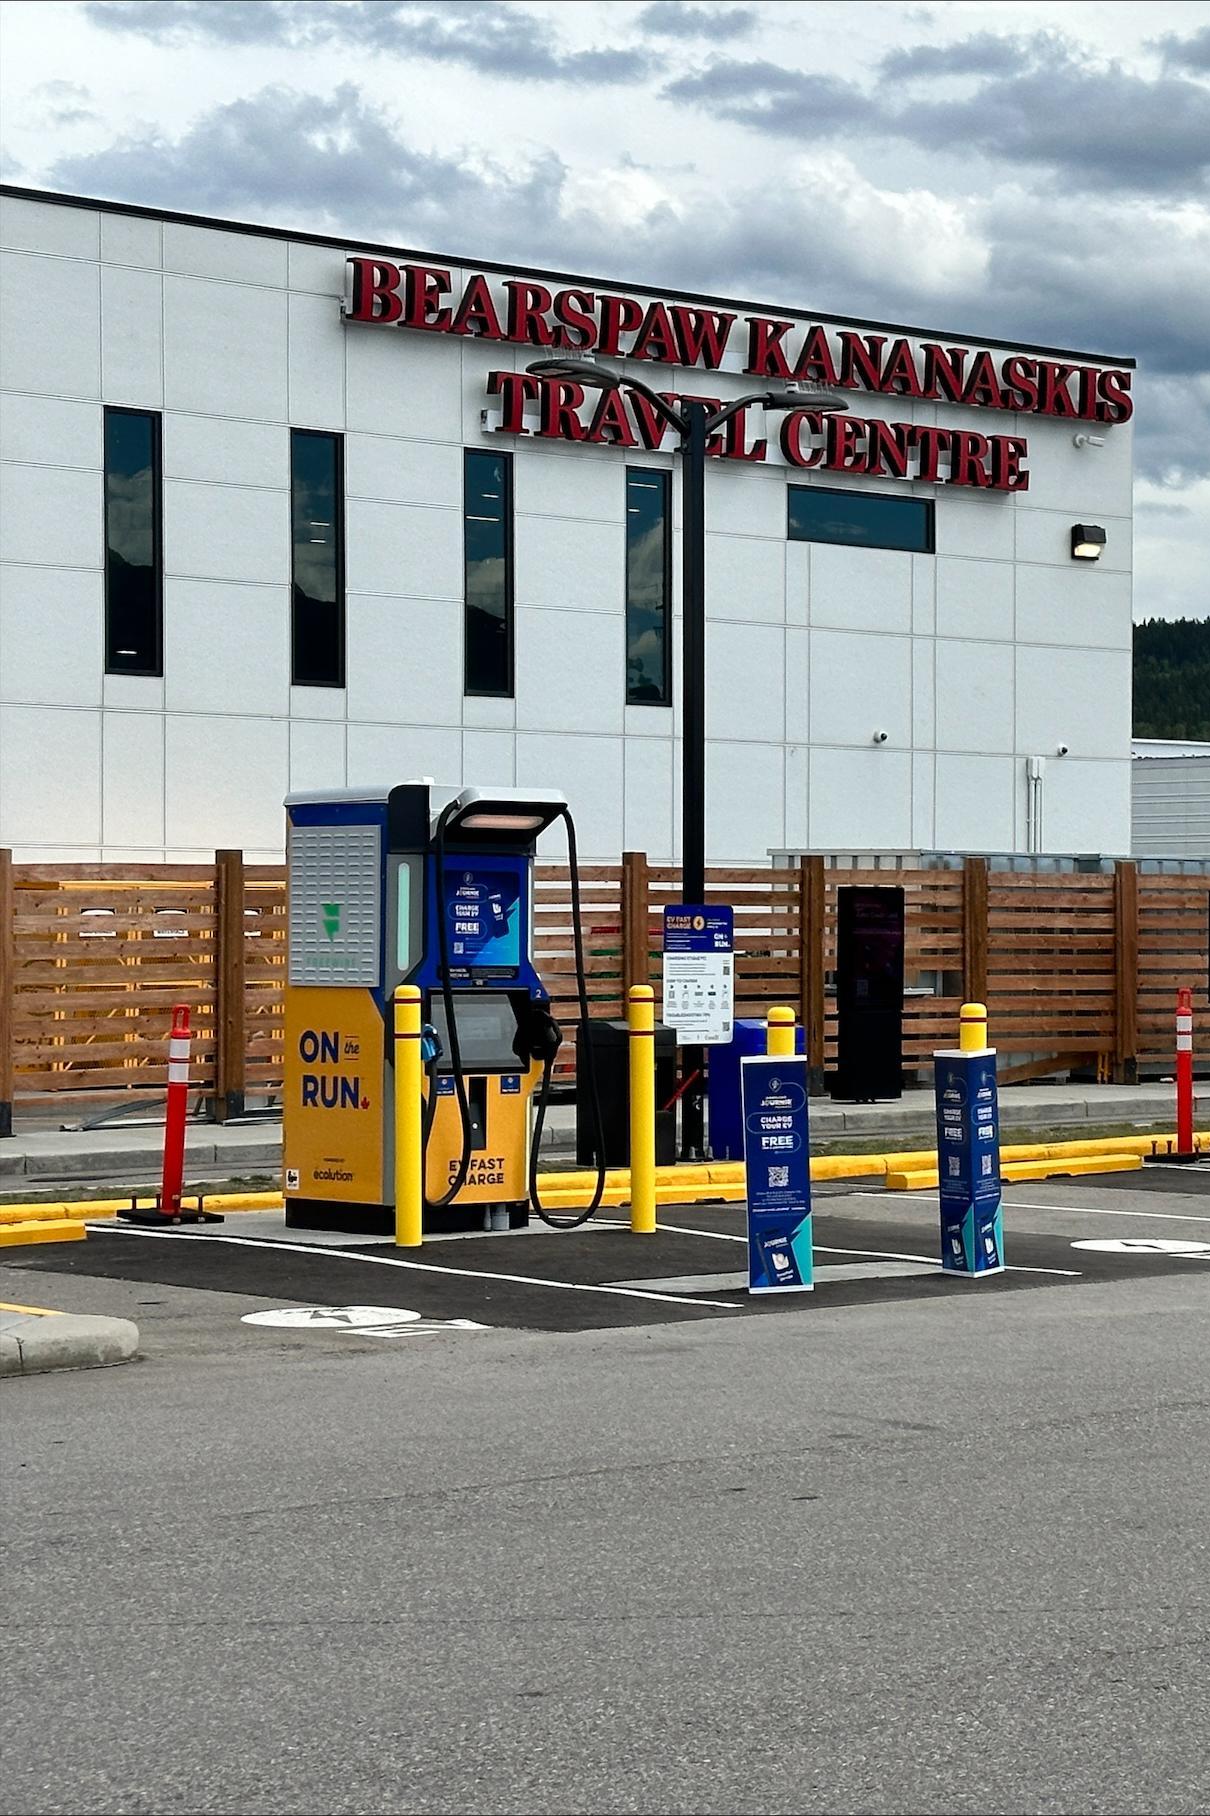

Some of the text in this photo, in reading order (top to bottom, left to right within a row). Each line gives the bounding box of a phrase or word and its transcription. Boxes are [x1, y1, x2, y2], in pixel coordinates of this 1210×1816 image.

[346, 257, 1133, 425] BEARSPAW KANANASKIS
[780, 410, 1030, 491] CENTRE
[455, 922, 480, 931] FREE
[535, 989, 542, 999] 2
[299, 1030, 360, 1063] ON the
[760, 1115, 793, 1124] CHARGE
[760, 1122, 782, 1130] YOUR
[761, 1135, 794, 1147] FREE
[470, 1158, 505, 1170] FAST
[448, 1173, 504, 1187] CARGE
